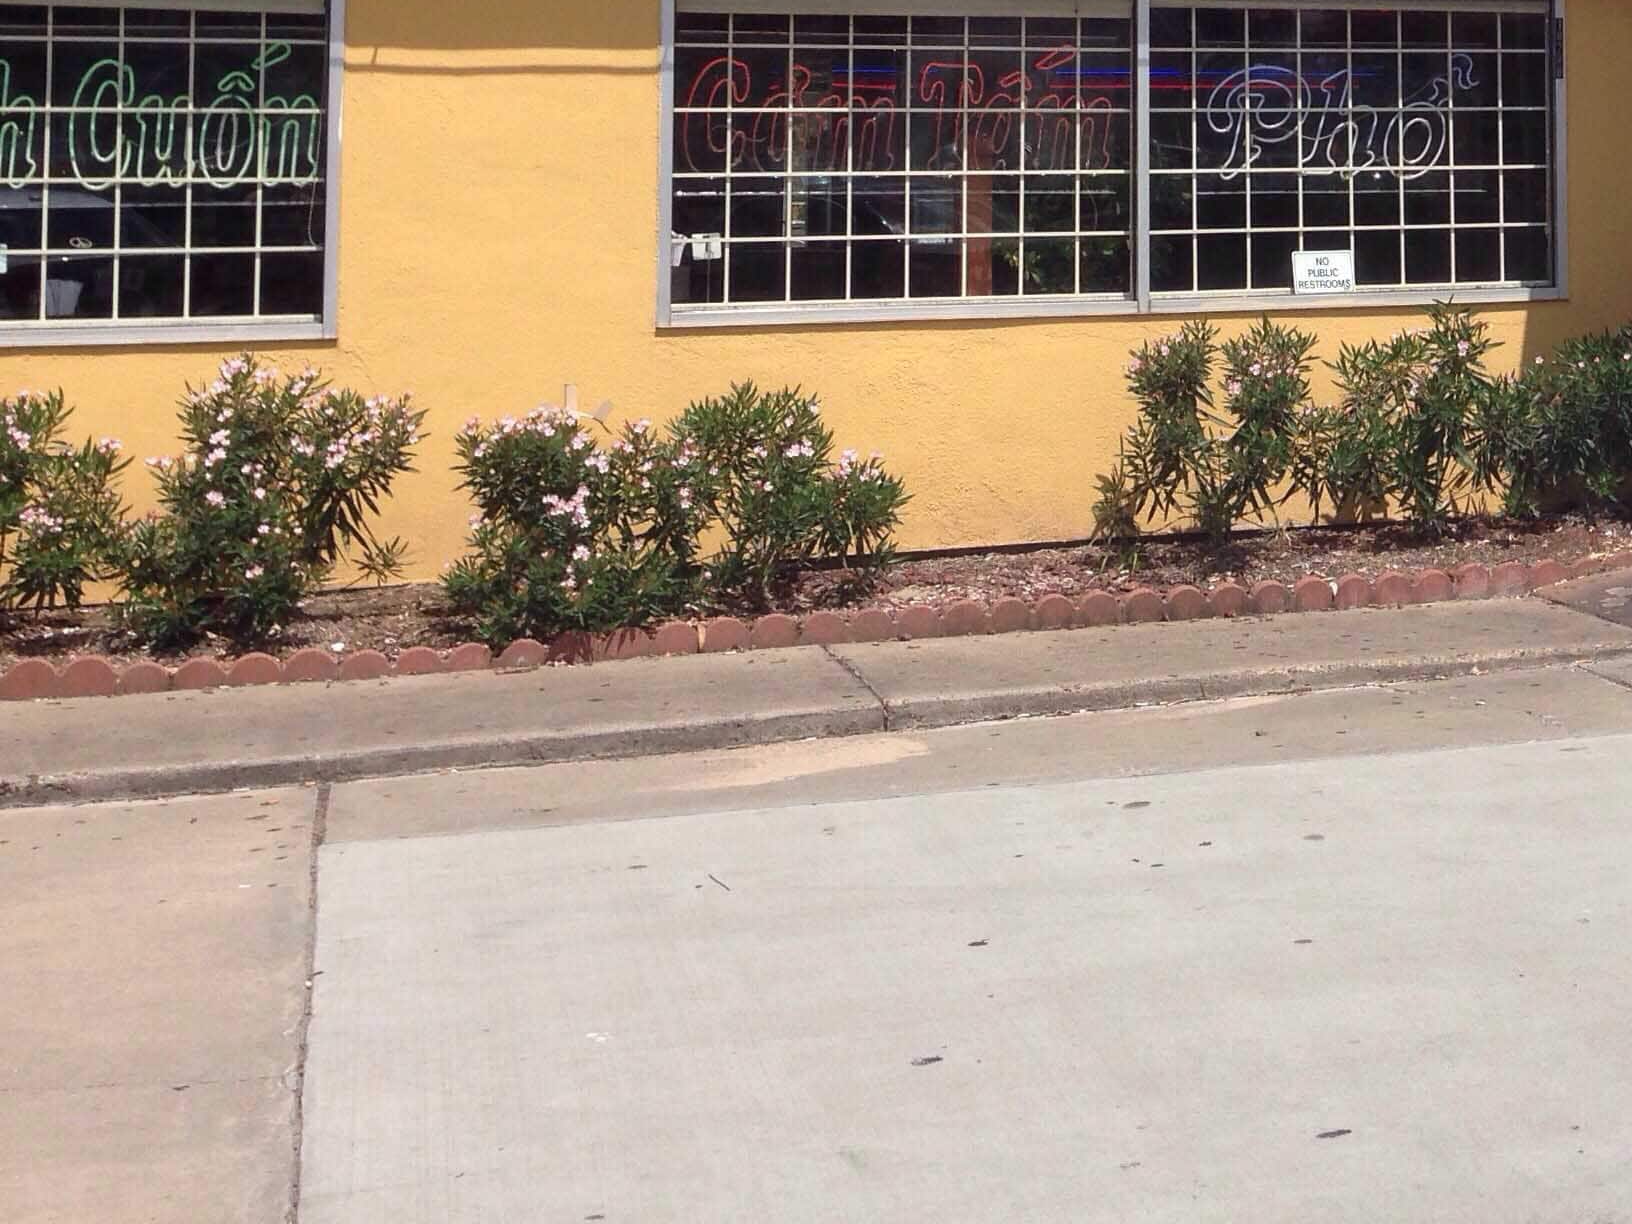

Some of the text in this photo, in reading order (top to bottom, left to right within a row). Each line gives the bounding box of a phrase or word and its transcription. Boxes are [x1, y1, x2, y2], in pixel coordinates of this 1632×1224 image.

[1315, 256, 1330, 266] NO
[1307, 267, 1340, 278] PUBLIC
[1297, 278, 1351, 290] RESTROOMS
